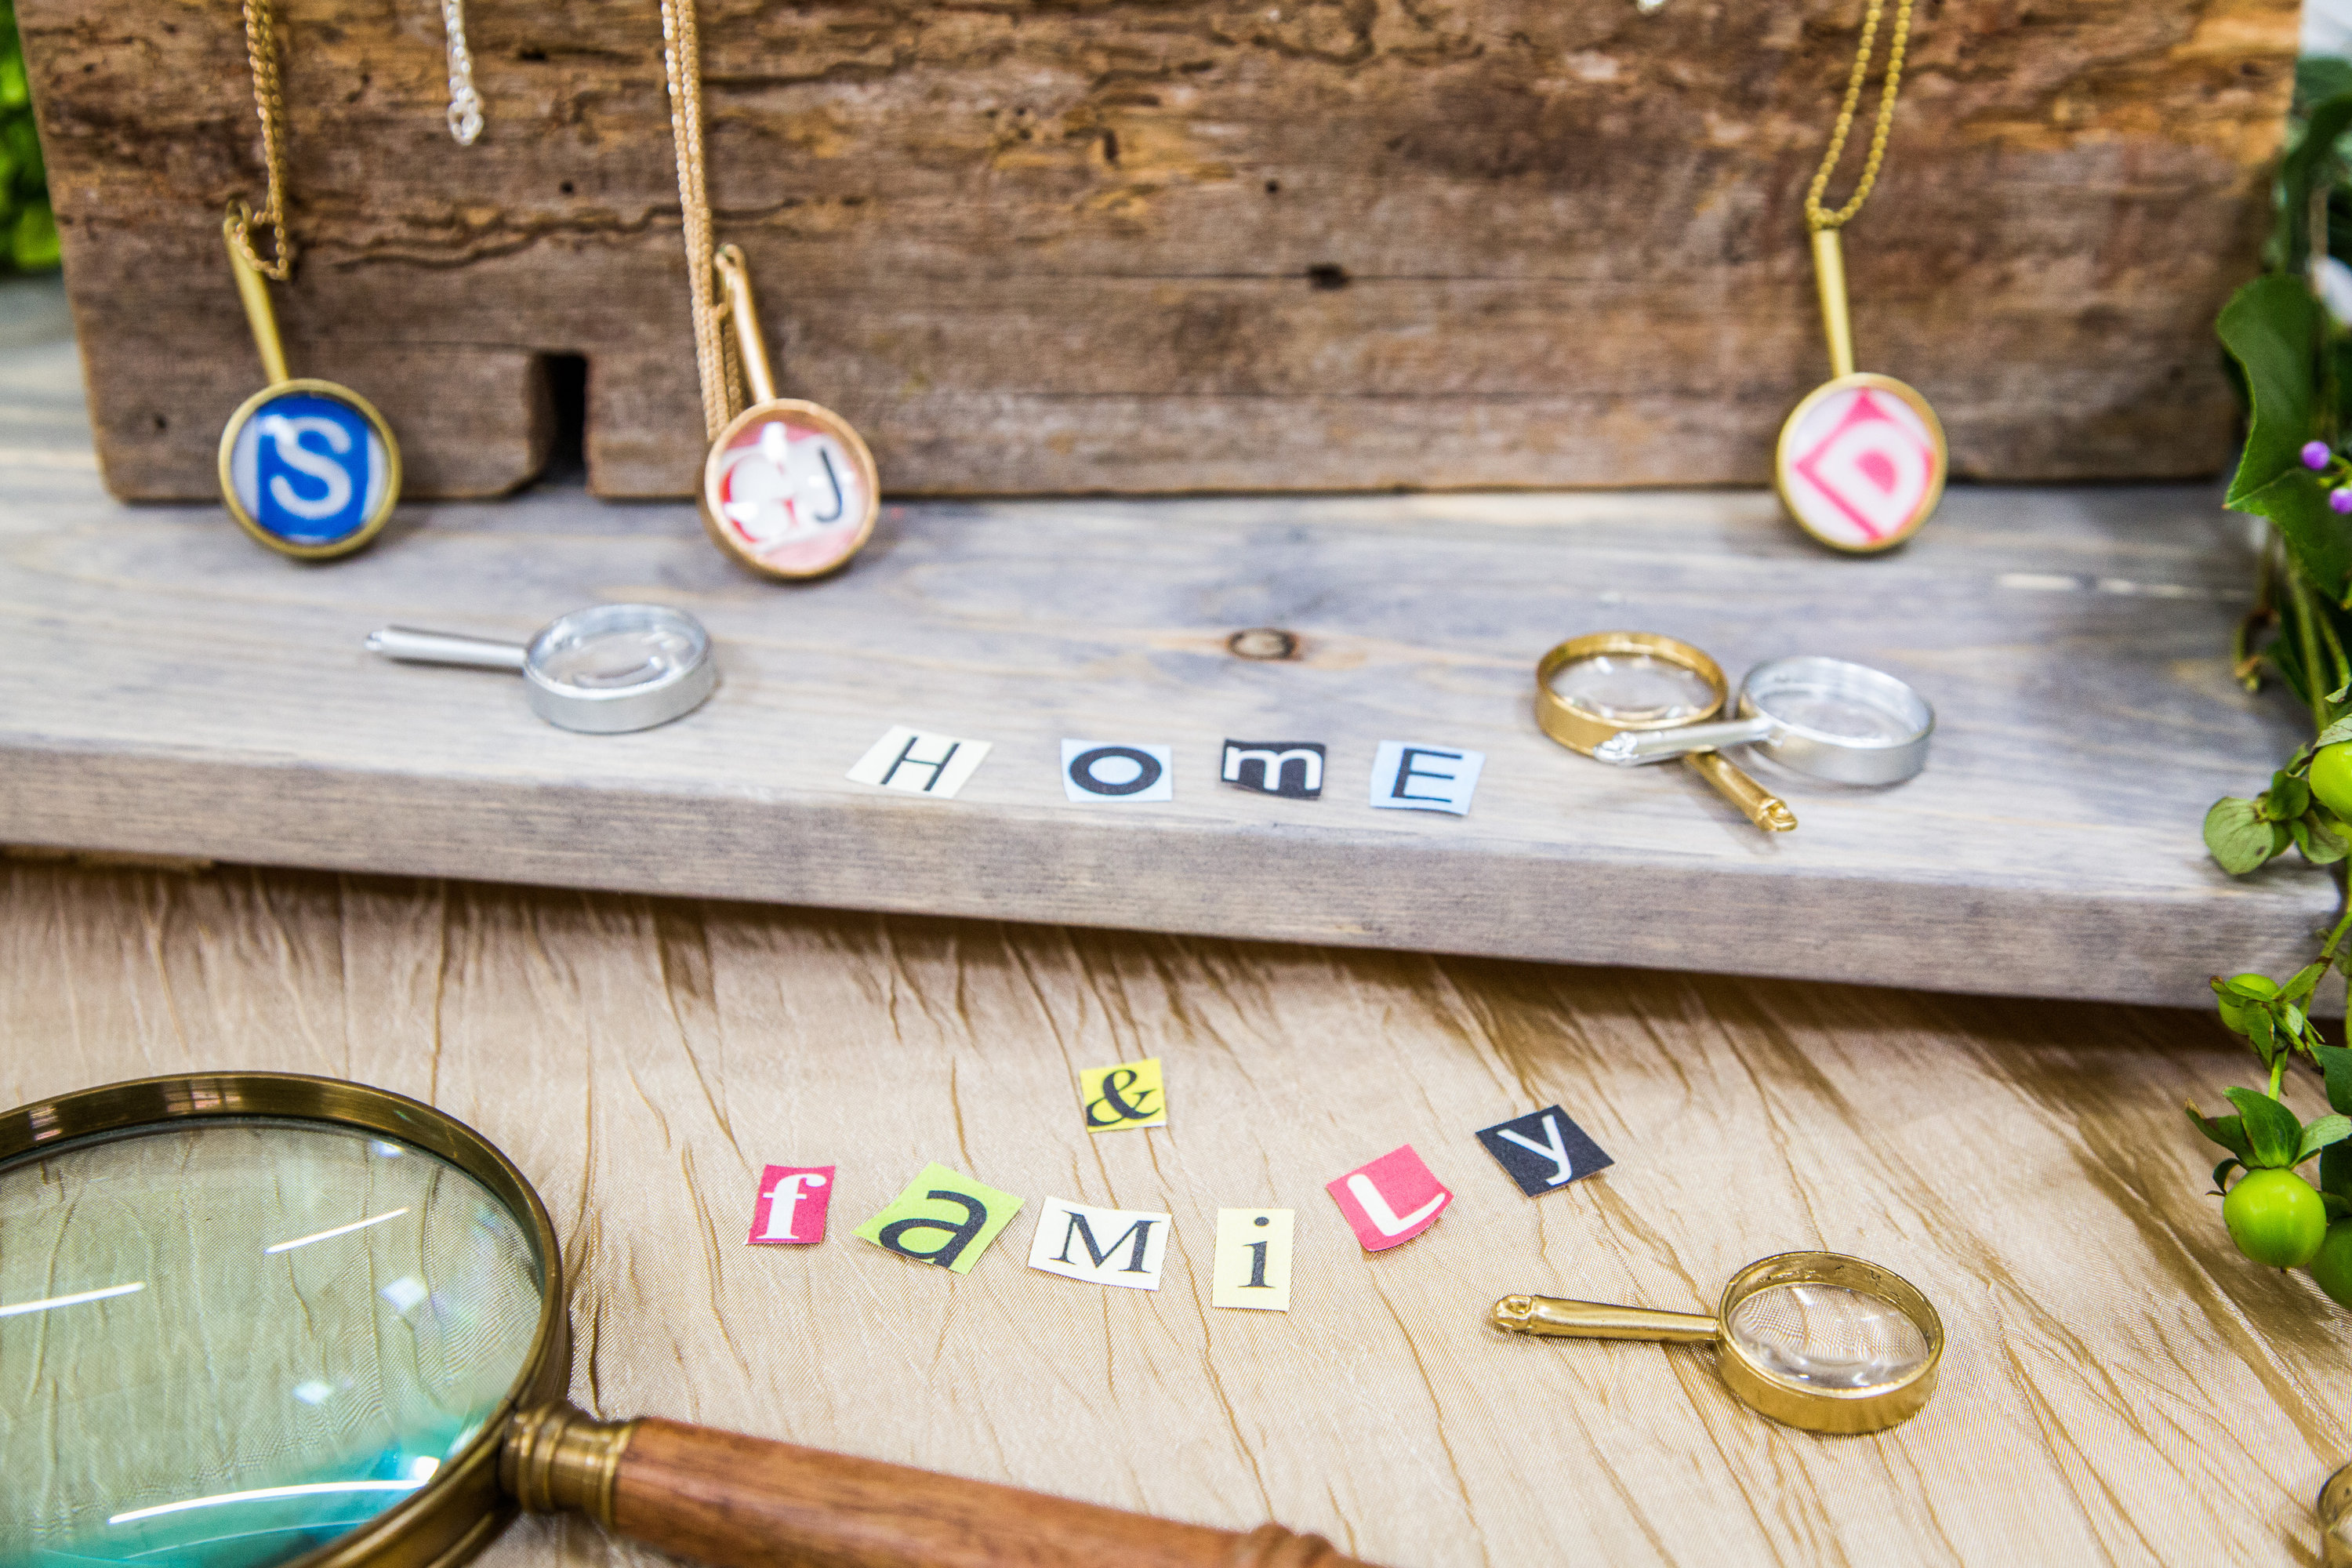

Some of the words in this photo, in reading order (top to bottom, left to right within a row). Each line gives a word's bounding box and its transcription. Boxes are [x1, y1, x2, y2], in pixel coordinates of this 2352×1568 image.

[269, 416, 351, 519] S
[1816, 419, 1923, 528] D
[1087, 1069, 1160, 1127] &
